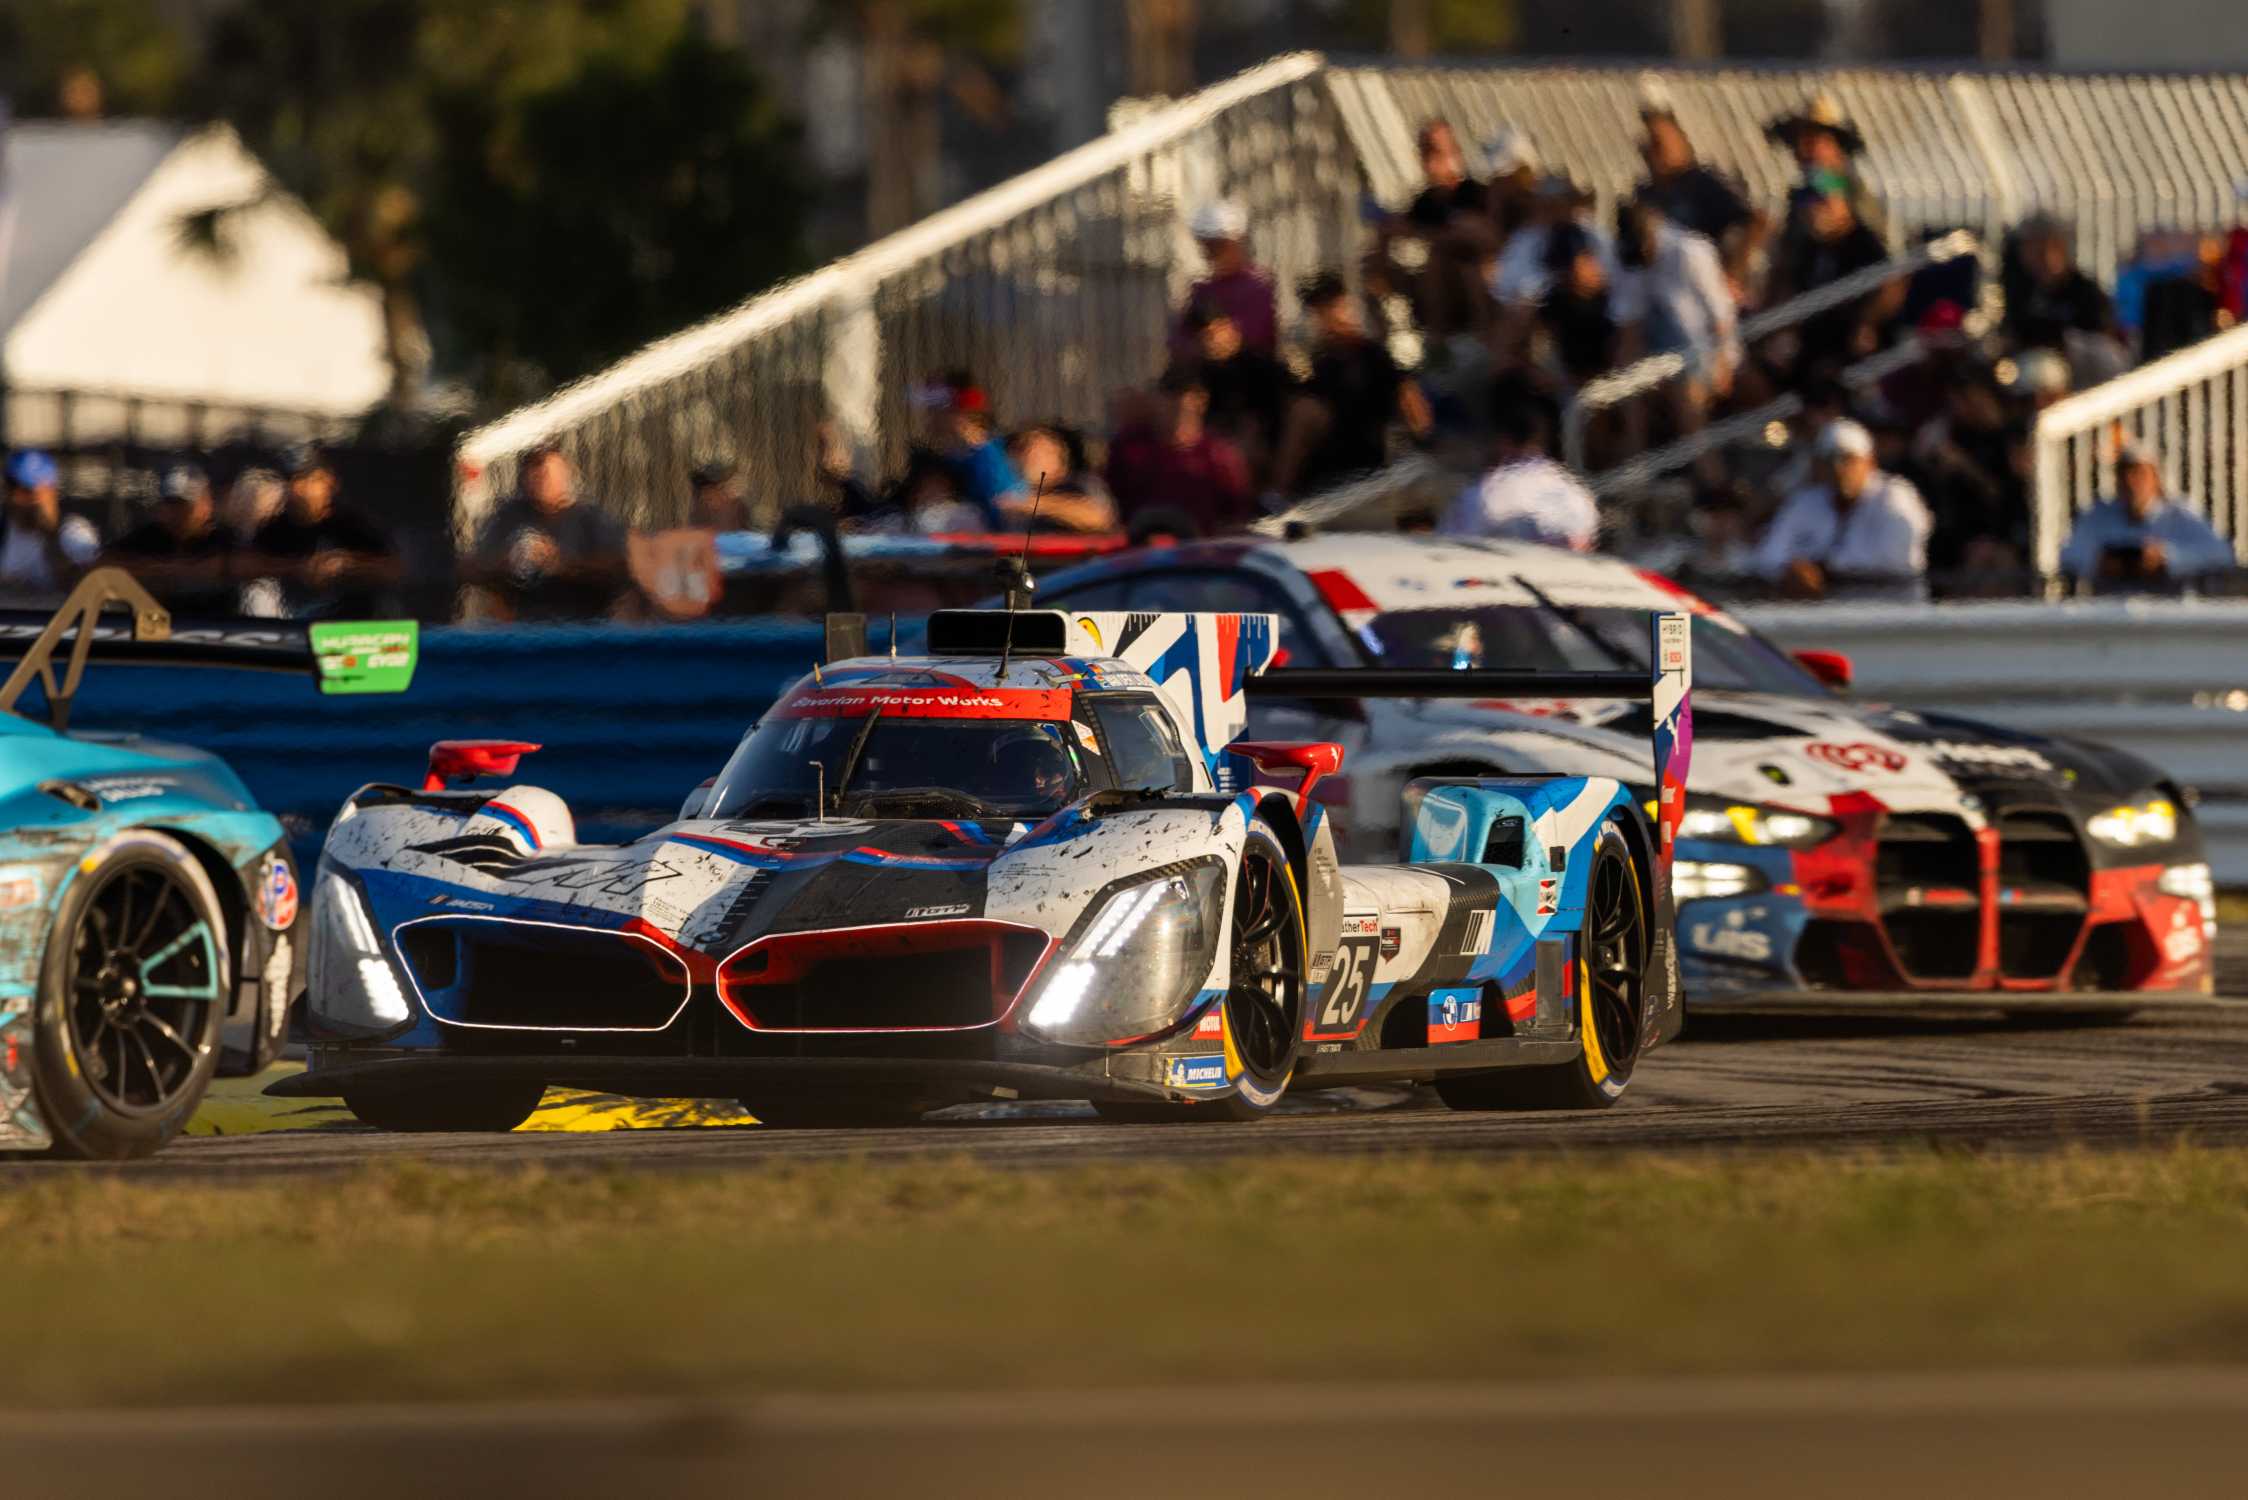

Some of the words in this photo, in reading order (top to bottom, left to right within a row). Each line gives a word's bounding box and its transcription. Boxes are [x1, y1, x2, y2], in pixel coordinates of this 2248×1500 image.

[869, 696, 934, 706] Motor
[934, 696, 1003, 707] Works
[1341, 920, 1378, 934] atherTech
[1321, 945, 1371, 1025] 25
[1187, 1066, 1222, 1081] MICHELIN
